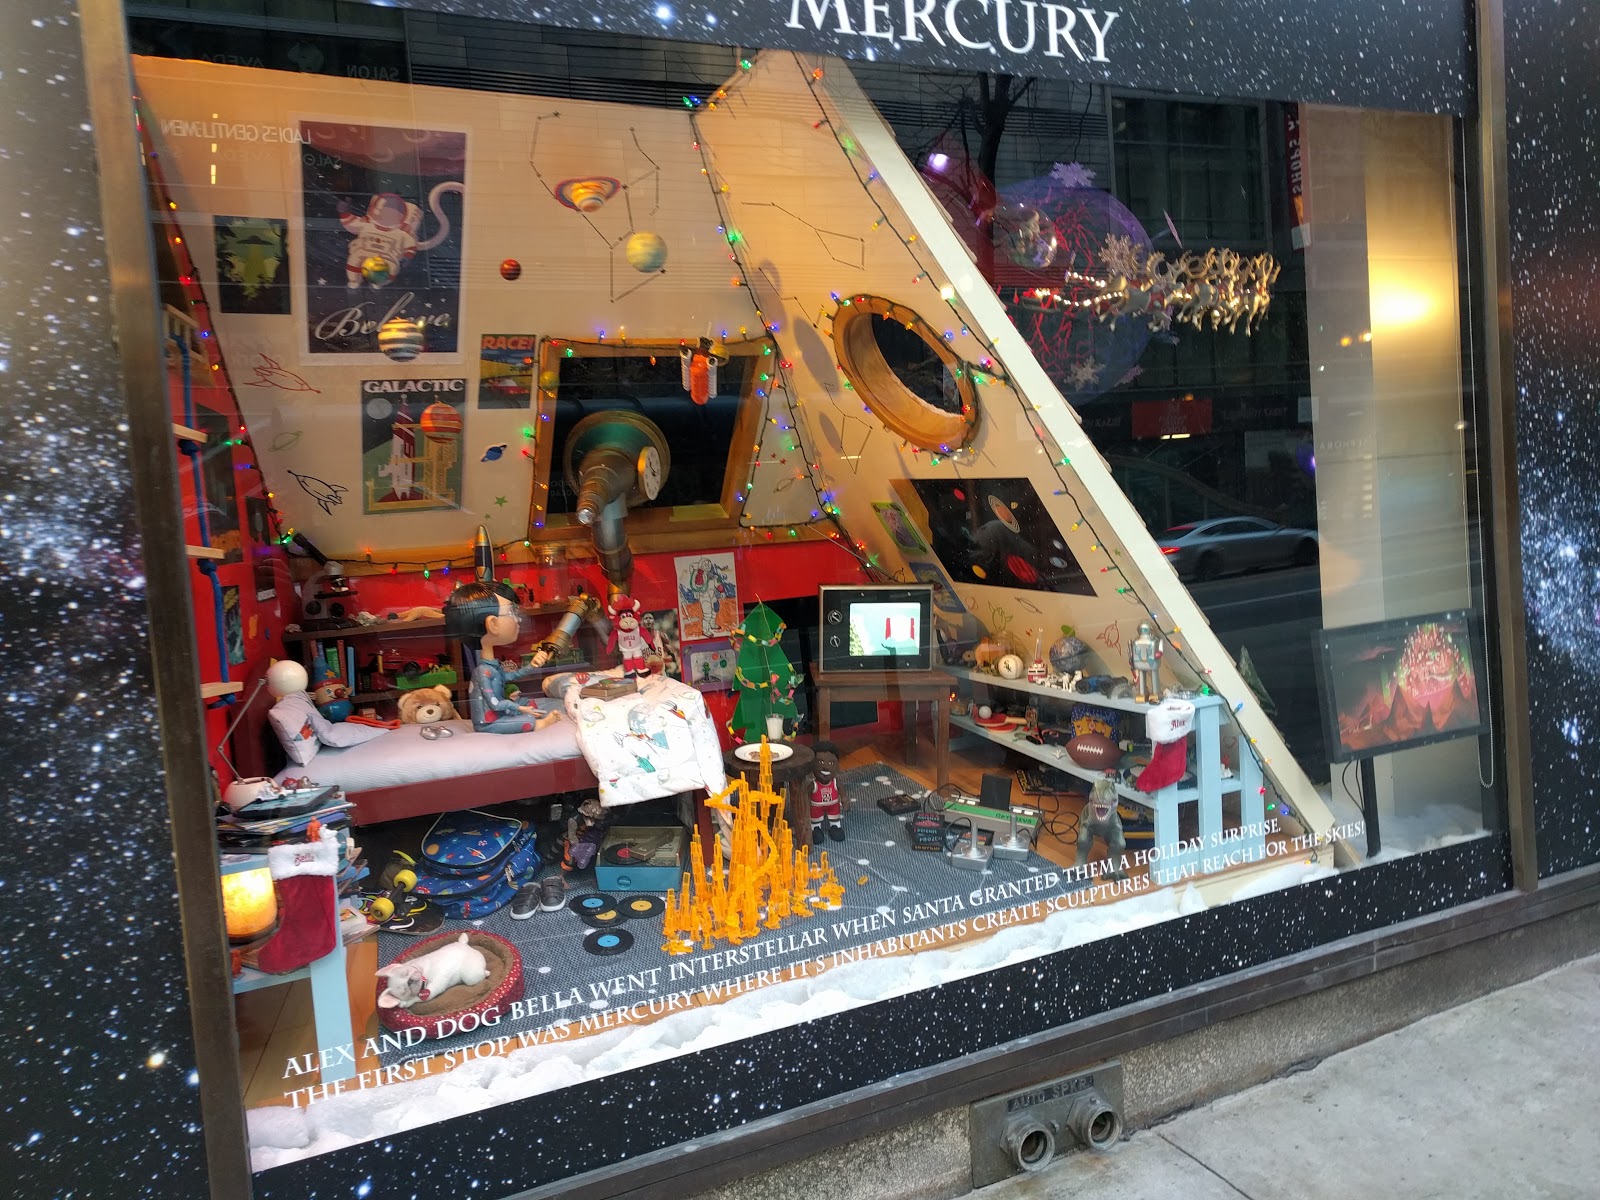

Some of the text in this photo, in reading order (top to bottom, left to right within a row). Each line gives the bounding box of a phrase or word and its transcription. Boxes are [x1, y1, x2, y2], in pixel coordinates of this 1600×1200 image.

[784, 0, 1119, 63] MERCURY
[314, 291, 453, 342] Belve
[363, 379, 464, 394] GALACTIC
[1170, 718, 1186, 731] Alex
[283, 1042, 356, 1079] ALEX
[361, 1026, 427, 1060] AND
[435, 1006, 502, 1040] DOG
[509, 984, 585, 1022] BELLA
[588, 967, 661, 998] WENT
[669, 926, 829, 983] INTERSTELLAR
[831, 909, 897, 943] WHEN
[903, 893, 965, 924] SANTA
[969, 872, 1059, 907] GRANTED
[1062, 857, 1115, 887] THEM
[1118, 855, 1131, 870] A
[1134, 835, 1207, 867] HOLIDAY
[283, 1078, 346, 1110] THE
[355, 1055, 436, 1091] FIRST
[444, 1035, 511, 1071] STOP
[515, 1023, 572, 1050] WAS
[578, 985, 698, 1036] MERCURY
[700, 962, 783, 1000] WHERE
[830, 918, 969, 969] INHABITANTS
[971, 902, 1042, 934] CREATE
[1046, 874, 1151, 914] SCULPTURES
[1154, 863, 1199, 887] THAT
[1202, 848, 1255, 871] REACH
[1258, 838, 1288, 860] FOR
[1290, 829, 1324, 851] THE
[1325, 820, 1366, 846] SKIES!
[1012, 1093, 1046, 1111] AUTO
